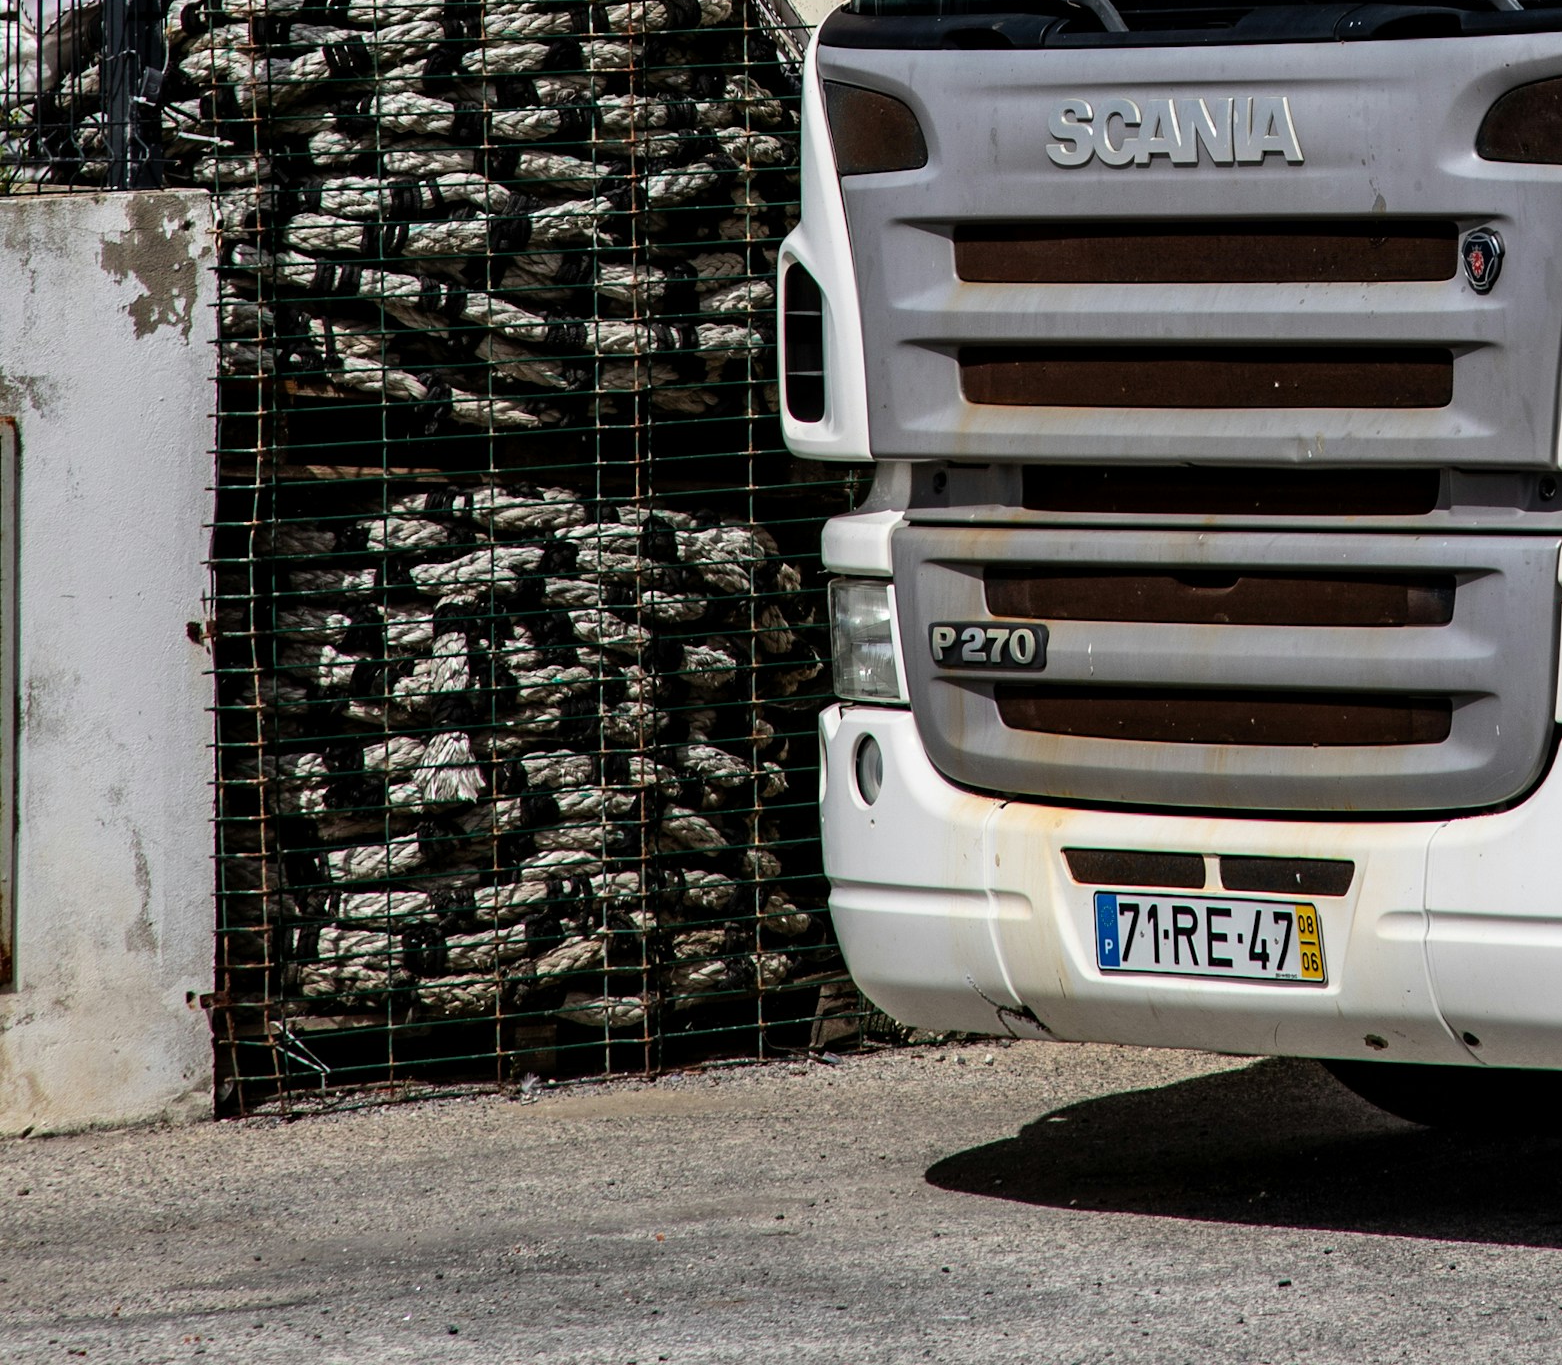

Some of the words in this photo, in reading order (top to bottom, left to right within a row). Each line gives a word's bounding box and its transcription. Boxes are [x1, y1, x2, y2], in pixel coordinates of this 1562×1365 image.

[1045, 96, 1305, 168] SCANIA
[931, 626, 957, 661] P
[961, 626, 1036, 665] 270
[1298, 914, 1315, 934] 08
[1104, 938, 1113, 955] P
[1301, 952, 1319, 972] 06
